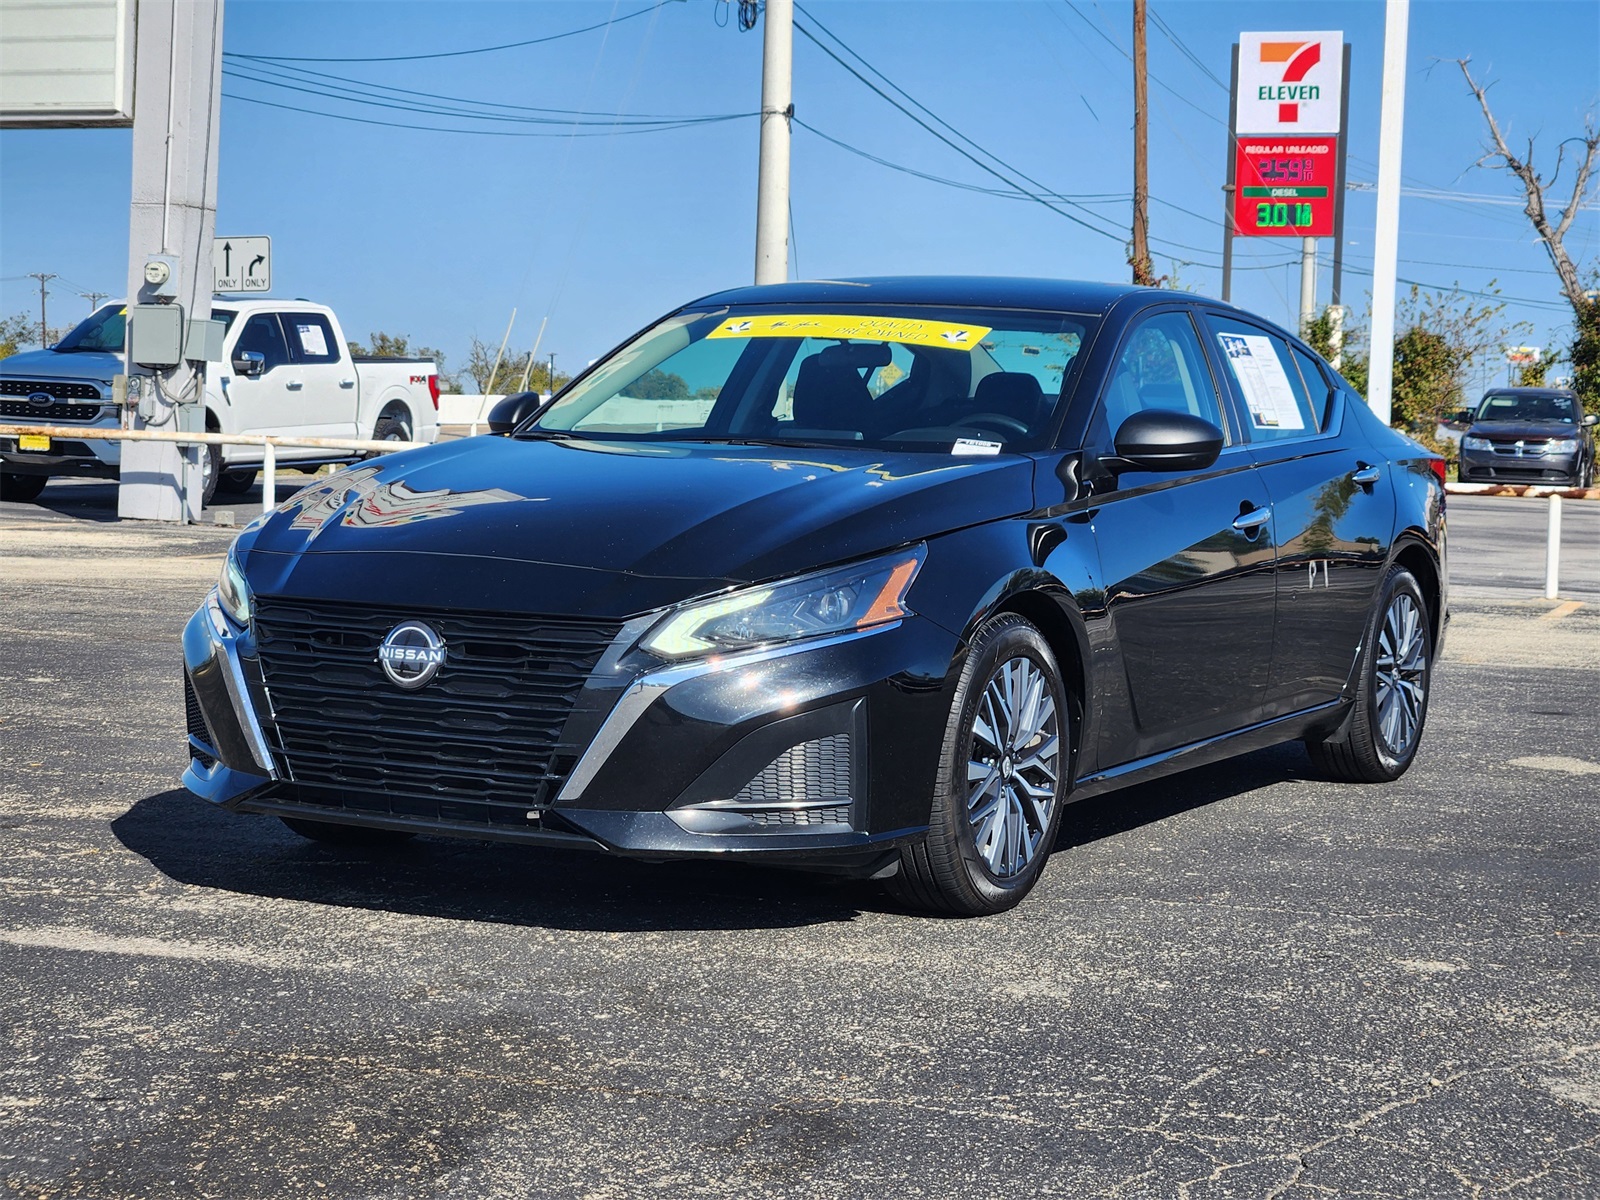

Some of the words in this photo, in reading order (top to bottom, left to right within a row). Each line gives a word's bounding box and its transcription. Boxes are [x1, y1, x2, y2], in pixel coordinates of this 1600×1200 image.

[1260, 41, 1321, 82] 7
[1245, 145, 1284, 154] REGULAR
[1285, 145, 1329, 154] UNLEADED
[1271, 188, 1298, 197] DIESEL
[218, 279, 237, 288] ONLY
[245, 278, 266, 288] ONLY
[859, 319, 924, 330] QUALITY
[866, 328, 929, 341] OWNED
[380, 647, 441, 661] NISSAN
